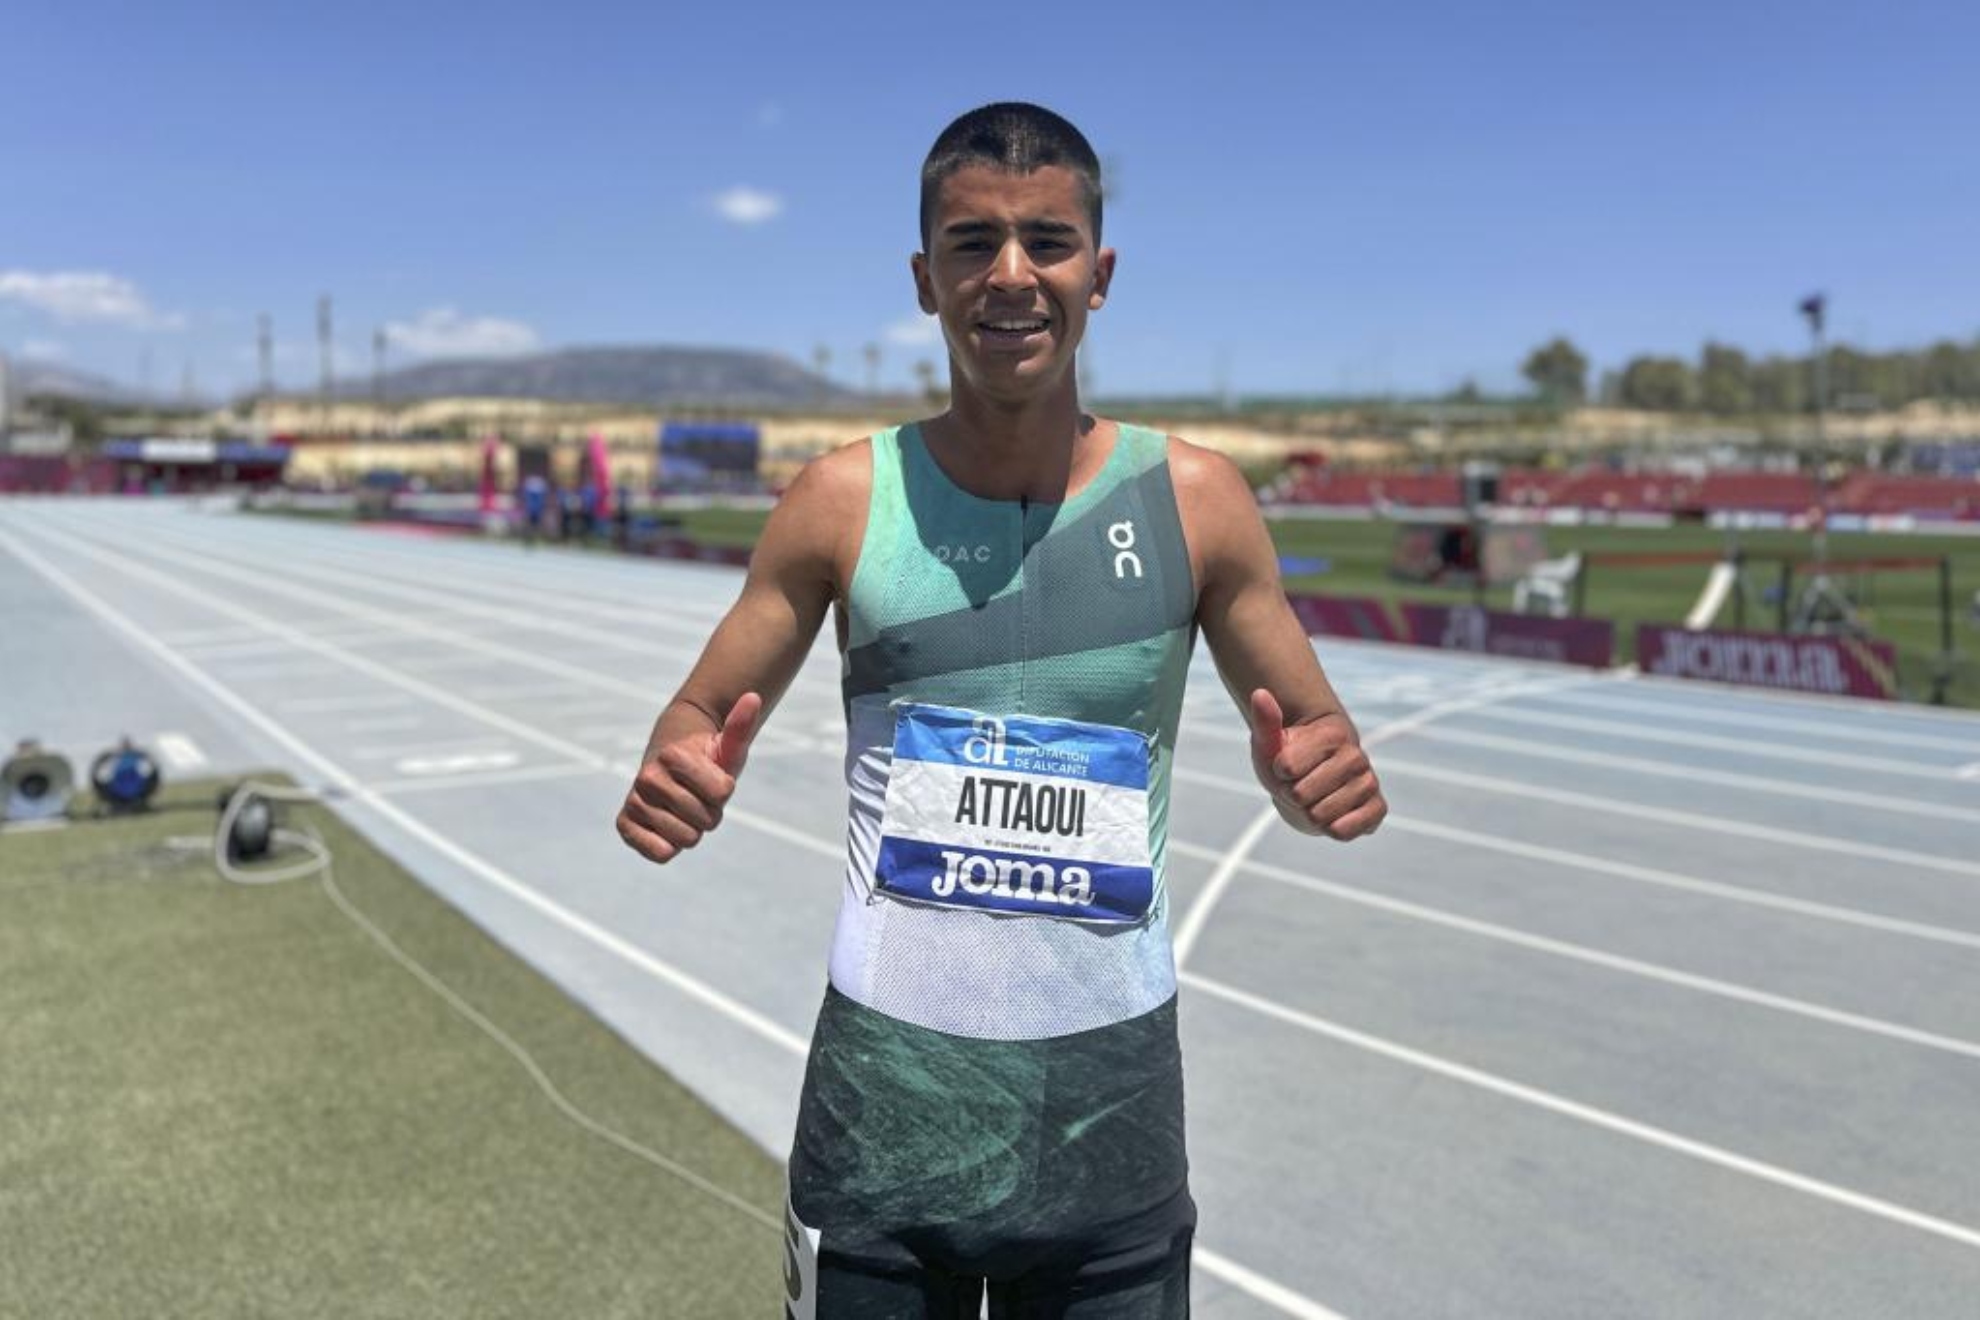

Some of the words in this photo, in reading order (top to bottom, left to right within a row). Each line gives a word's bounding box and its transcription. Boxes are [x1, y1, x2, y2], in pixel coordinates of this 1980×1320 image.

[1014, 758, 1030, 770] DE
[1032, 760, 1089, 777] ALICANTE
[955, 777, 1085, 837] ATTAOUI
